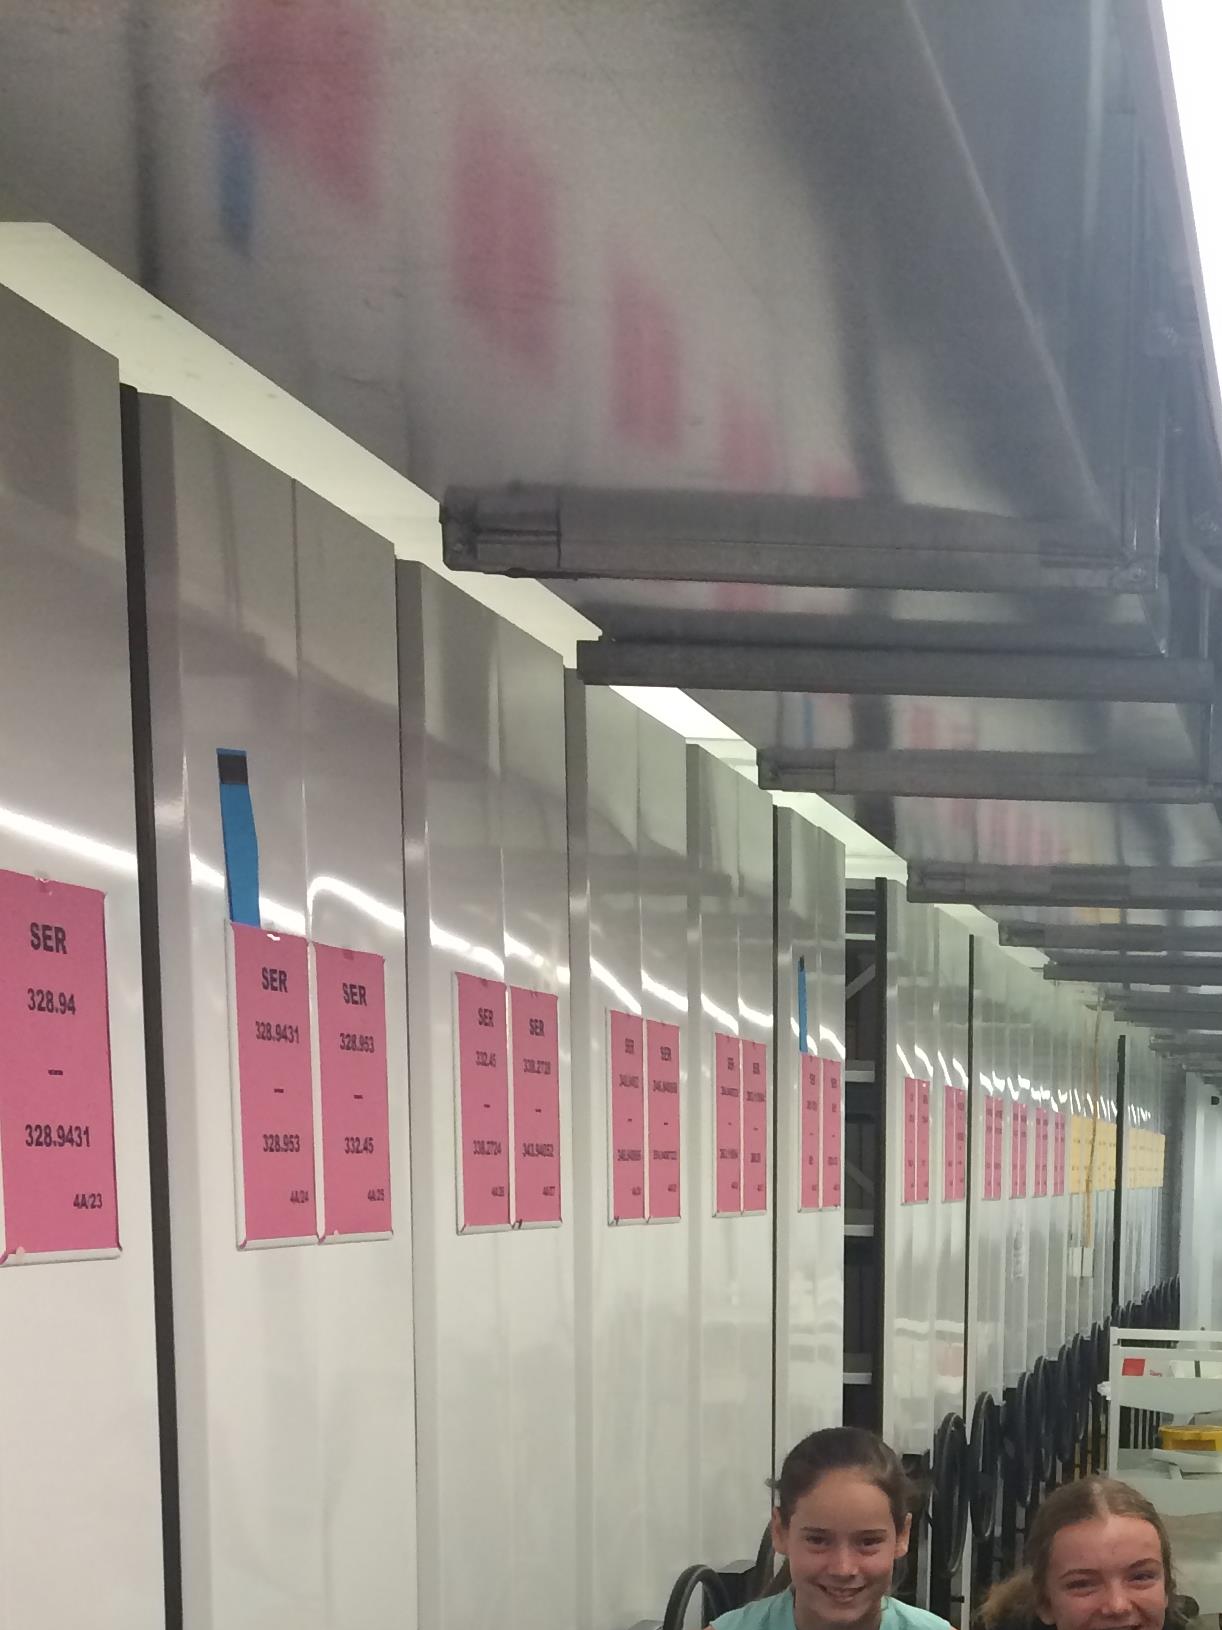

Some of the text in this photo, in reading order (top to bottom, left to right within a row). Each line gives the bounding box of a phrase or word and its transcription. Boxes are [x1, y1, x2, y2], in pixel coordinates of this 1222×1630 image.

[30, 922, 67, 954] SER
[262, 966, 288, 993] SER
[27, 988, 76, 1015] 328.94
[342, 982, 367, 1006] SER
[478, 1007, 494, 1028] SER
[529, 1018, 545, 1036] SER
[256, 1021, 300, 1044] 328.9431
[340, 1033, 375, 1053] 328.953
[25, 1124, 90, 1148] 328.9431
[263, 1134, 300, 1152] 328.953
[344, 1137, 374, 1154] 332.45
